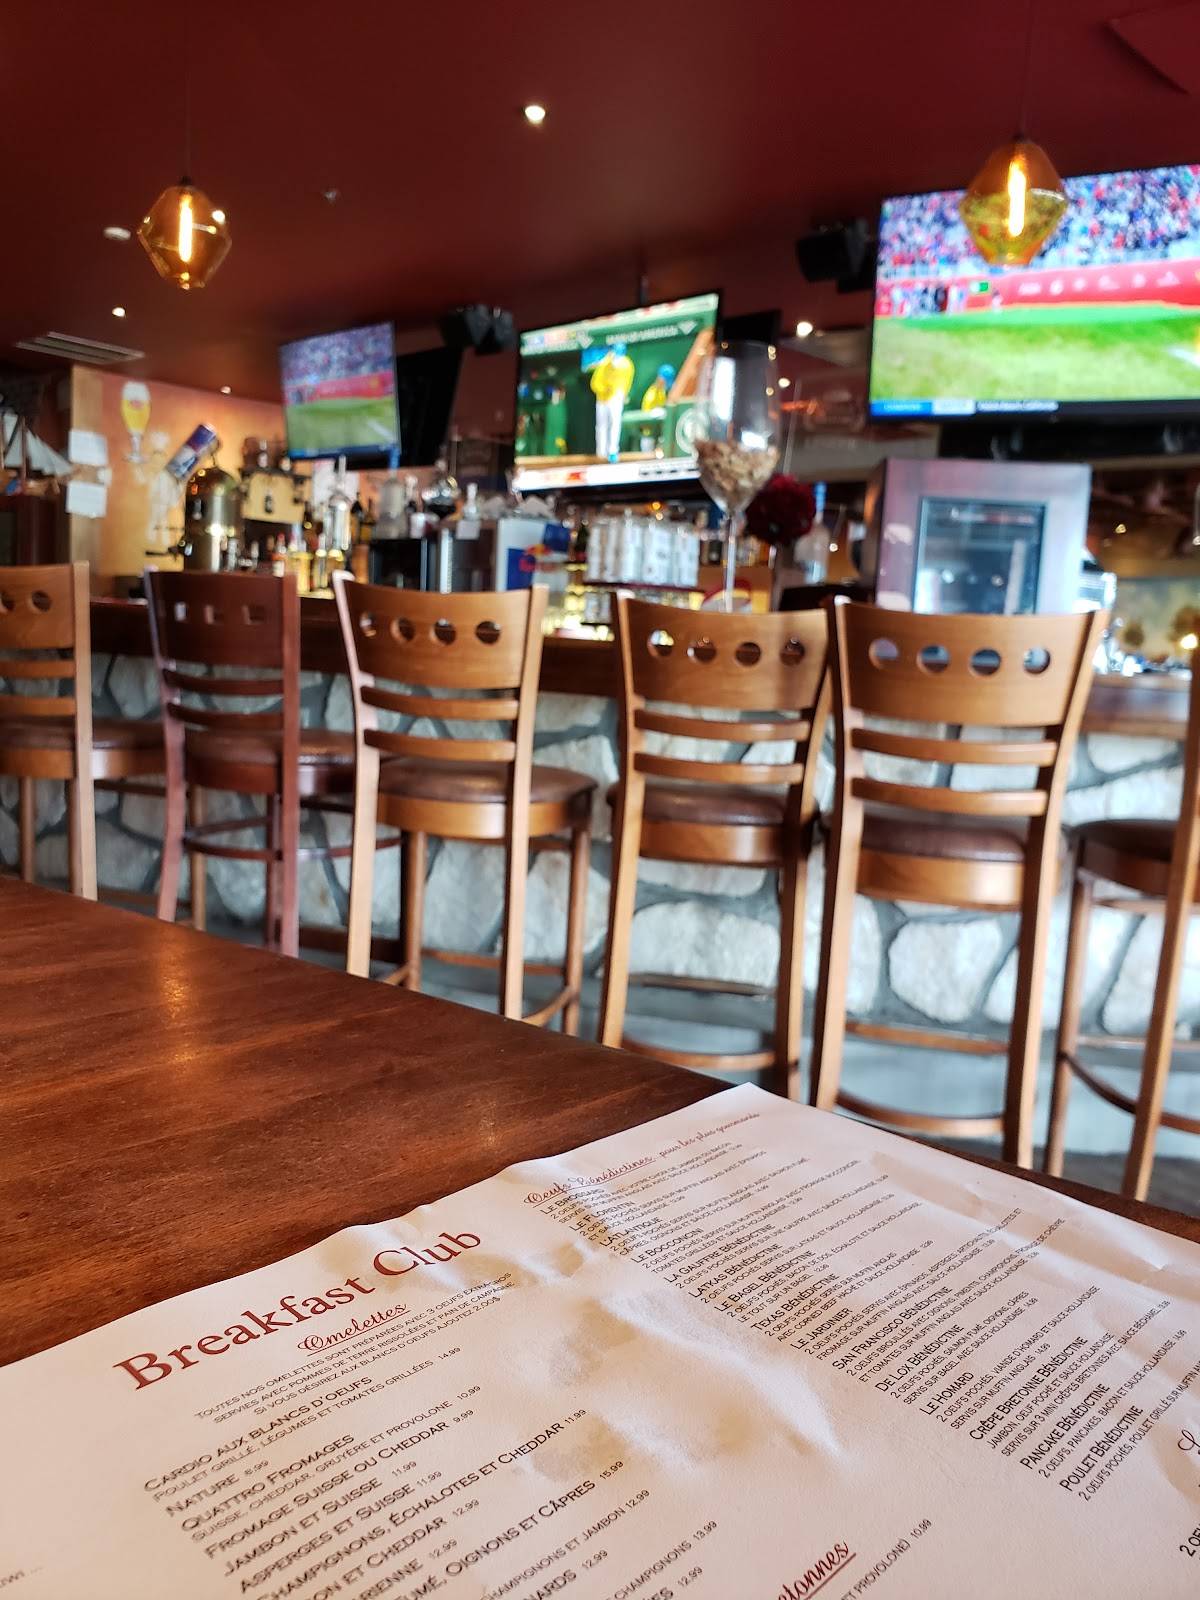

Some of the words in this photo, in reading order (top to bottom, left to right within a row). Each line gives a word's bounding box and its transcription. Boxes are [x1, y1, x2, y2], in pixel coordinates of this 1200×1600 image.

[539, 1204, 558, 1214] LE
[568, 1220, 587, 1231] LE
[582, 1201, 635, 1226] FLORENTIN
[630, 1253, 649, 1263] LE
[644, 1227, 704, 1256] BOCCONCINI
[663, 1273, 682, 1283] LA
[678, 1250, 723, 1274] GAUFFRE
[718, 1223, 775, 1252] BÉNÉDICTINE
[688, 1273, 728, 1298] LATKAS
[723, 1243, 782, 1275] BÉNÉDICTINE
[713, 1300, 733, 1312] LE
[729, 1282, 763, 1302] BAGEL
[757, 1250, 815, 1282] BÉNÉDICTINE
[113, 1277, 375, 1390] Breakfast
[373, 1232, 481, 1276] Club
[297, 1303, 409, 1351] Omelettes
[750, 1309, 785, 1330] TEXAS
[780, 1273, 839, 1311] BÉNÉDICTINE
[789, 1338, 810, 1349] LE
[806, 1307, 853, 1340] JARDINIER
[832, 1352, 857, 1369] SAN
[851, 1318, 903, 1354] FRANCISCO
[898, 1286, 952, 1319] BÉNÉDICTINE
[194, 1395, 240, 1418] TOUTES
[240, 1384, 265, 1399] NOS
[265, 1359, 324, 1386] OMELETTES
[324, 1346, 350, 1361] SONT
[351, 1323, 404, 1349] PRÉPARÉES
[404, 1312, 427, 1326] AVEC
[435, 1293, 464, 1310] OEUFS
[214, 1398, 259, 1423] SERVIES
[261, 1385, 288, 1401] AVEC
[288, 1366, 336, 1388] POMMES
[331, 1359, 348, 1369] DE
[345, 1345, 378, 1363] TERRE
[377, 1323, 426, 1348] RISSOLÉES
[425, 1316, 438, 1326] ET
[437, 1307, 459, 1319] PAIN
[457, 1300, 471, 1309] DE
[253, 1406, 267, 1415] SI
[266, 1392, 297, 1408] VOUS
[297, 1373, 340, 1394] DÉSIREZ
[340, 1363, 360, 1375] AUX
[359, 1346, 398, 1366] BLANCS
[396, 1328, 436, 1348] D'OEUFS
[436, 1309, 474, 1330] AJOUTEZ
[874, 1378, 896, 1392] DE
[888, 1363, 914, 1380] LOX
[906, 1324, 964, 1364] BÉNÉDICTINE
[919, 1403, 940, 1415] LE
[931, 1372, 973, 1404] HOMARD
[969, 1411, 1004, 1440] CRÊPE
[995, 1374, 1044, 1414] BRETONNE
[1035, 1336, 1087, 1377] BÉNÉDICTINE
[1001, 1432, 1027, 1456] SERVIS
[1033, 1414, 1045, 1422] 3
[1040, 1402, 1058, 1417] MINI
[1053, 1382, 1080, 1404] CRÊPES
[1105, 1343, 1122, 1357] AVEC
[1117, 1327, 1138, 1345] SAUCE
[144, 1454, 212, 1491] CARDIO
[217, 1436, 248, 1457] AUX
[248, 1405, 310, 1439] BLANCS
[310, 1376, 372, 1408] D'OEUFS
[153, 1469, 207, 1502] POULET
[210, 1445, 260, 1471] GRILLÉ,
[260, 1415, 317, 1447] LÉGUMES
[316, 1406, 332, 1418] ET
[332, 1383, 384, 1408] TOMATES
[385, 1360, 433, 1385] GRILLÉES
[986, 1421, 1020, 1449] JAMBON,
[1015, 1403, 1034, 1421] OEUF
[1031, 1384, 1056, 1406] POCHÉ
[1050, 1377, 1063, 1387] ET
[1058, 1361, 1082, 1380] SAUCE
[1017, 1428, 1064, 1469] PANCAKE
[1055, 1383, 1110, 1430] BÉNÉDICTINE
[1038, 1468, 1051, 1478] 2
[1045, 1447, 1073, 1471] OEUFS,
[1067, 1415, 1104, 1448] PANCAKES,
[1097, 1394, 1122, 1416] BACON
[1116, 1386, 1128, 1396] ET
[1123, 1371, 1146, 1389] SAUCE
[1059, 1453, 1097, 1490] POULET
[1089, 1405, 1143, 1457] BÉNÉDICTINE
[181, 1482, 265, 1531] QUATTRO
[266, 1434, 354, 1484] FROMAGES
[191, 1510, 248, 1541] SUISSE,
[249, 1472, 314, 1510] CHEDDAR,
[315, 1440, 370, 1472] GRUYÈRE
[369, 1432, 384, 1444] ET
[386, 1400, 452, 1436] PROVOLONE
[205, 1504, 293, 1558] FROMAGE
[293, 1470, 353, 1506] SUISSE
[353, 1456, 378, 1472] OU
[378, 1422, 449, 1458] CHEDDAR
[389, 1472, 479, 1526] ÉCHALOTES
[478, 1461, 497, 1476] ET
[498, 1423, 564, 1463] CHEDDAR
[1078, 1491, 1091, 1501] 2
[1085, 1468, 1111, 1494] OEUFS
[1104, 1443, 1136, 1471] POCHÉS,
[1128, 1418, 1154, 1444] POULET
[1149, 1398, 1172, 1420] GRILLÉ
[166, 1474, 239, 1516] NATURE
[225, 1526, 298, 1576] JAMBON
[299, 1510, 320, 1529] ET
[322, 1477, 382, 1514] SUISSE
[564, 1537, 580, 1551] ET
[582, 1507, 625, 1541] JAMBON
[241, 1531, 332, 1593] ASPERGES
[332, 1516, 354, 1535] ET
[355, 1483, 415, 1520] SUISSE
[312, 1581, 342, 1600] ON
[341, 1564, 364, 1585] ET
[366, 1517, 446, 1567] CHEDDAR
[359, 1558, 423, 1600] RIENNE
[393, 1575, 447, 1600] UMÉ,
[445, 1527, 520, 1576] OIGNONS
[518, 1513, 538, 1531] ET
[538, 1480, 595, 1517] CÂPRES
[614, 1540, 691, 1599] CHAMPIGNONS
[853, 1539, 910, 1594] PROVOLONE)
